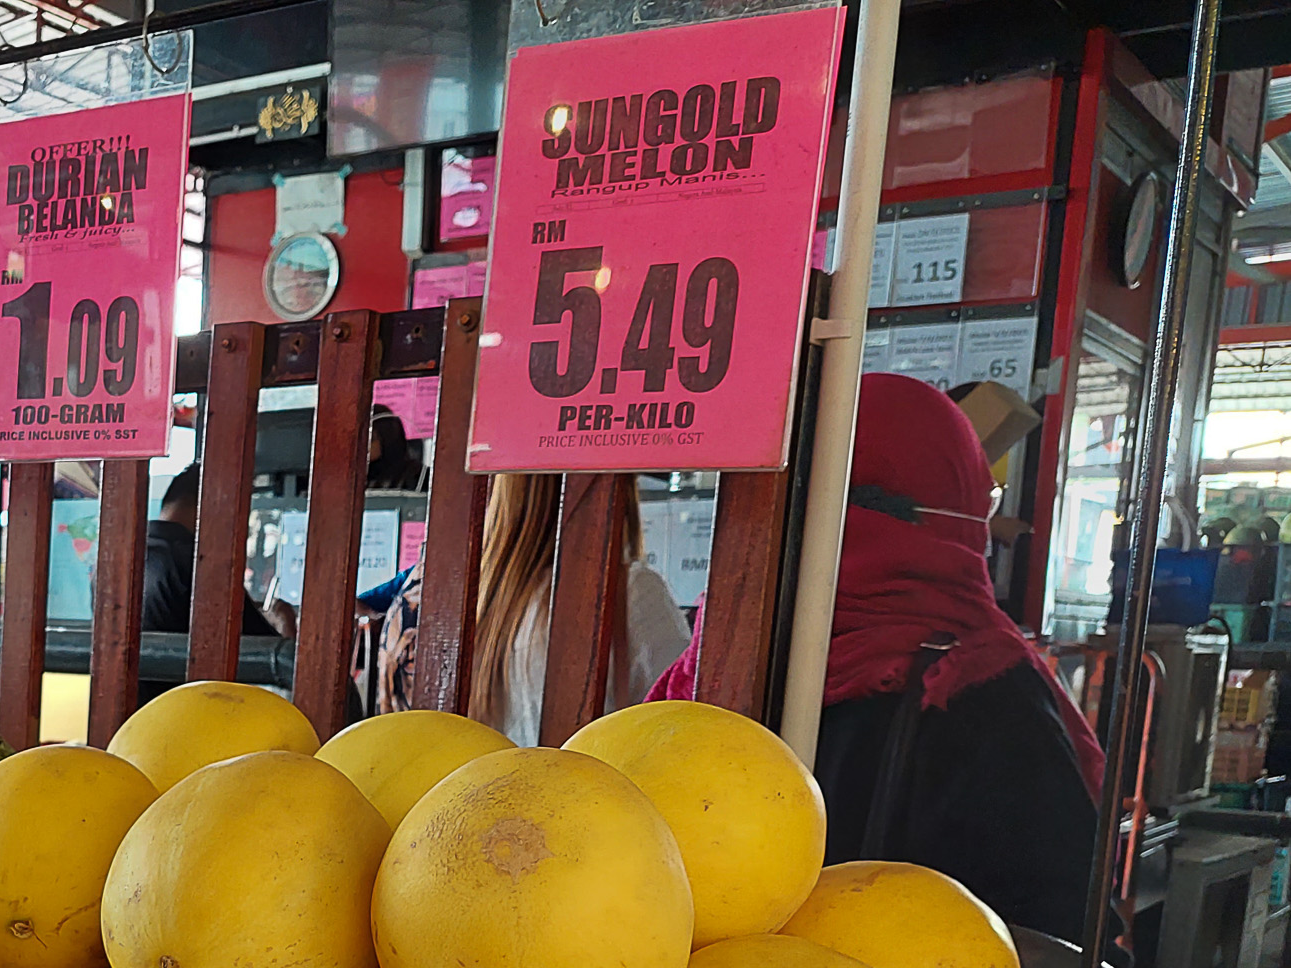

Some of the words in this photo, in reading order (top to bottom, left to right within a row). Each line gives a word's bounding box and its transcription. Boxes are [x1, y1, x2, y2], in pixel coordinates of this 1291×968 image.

[542, 76, 781, 159] SUNGOLD
[30, 134, 130, 163] OFFER!!!
[6, 147, 149, 206] DURIAN
[556, 136, 754, 190] MELON
[551, 179, 650, 198] Rangup
[17, 191, 135, 236] BELANDA
[19, 230, 59, 244] Fresh
[63, 229, 78, 239] &
[531, 219, 567, 244] RM
[912, 259, 958, 284] 115
[528, 246, 740, 398] 5.49
[1, 281, 140, 400] 1.09
[989, 357, 1019, 379] 65
[11, 402, 126, 426] 100-GRAM
[558, 401, 696, 431] PER-KILO
[28, 429, 90, 442] INCLUSIVE
[93, 429, 111, 441] 0%
[114, 428, 139, 441] SST
[538, 434, 576, 447] PRICE
[579, 433, 650, 447] INCLUSIVE
[652, 432, 674, 446] 0%
[677, 431, 705, 445] GST
